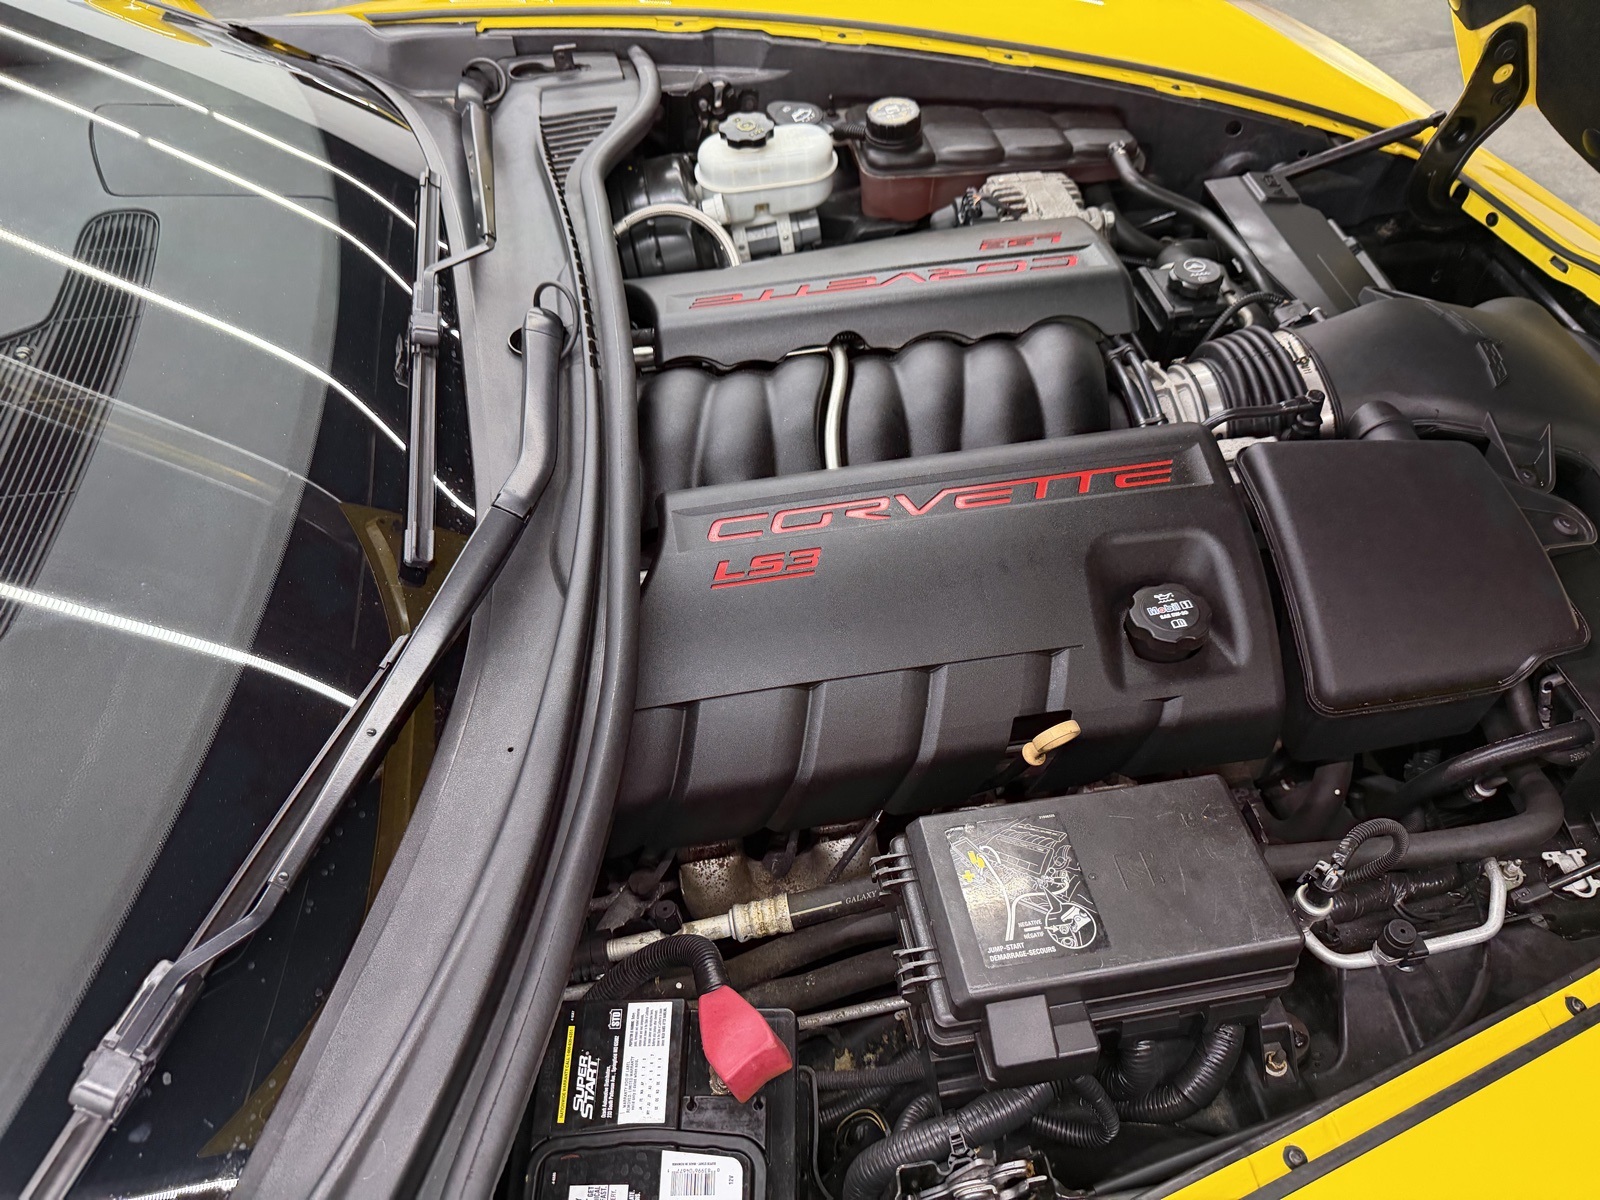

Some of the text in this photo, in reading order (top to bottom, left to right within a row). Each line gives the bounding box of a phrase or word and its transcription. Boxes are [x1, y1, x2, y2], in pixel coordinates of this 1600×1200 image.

[979, 232, 1062, 250] LS3
[689, 255, 1078, 309] CORVETTE
[707, 459, 1173, 542] CORVETTE
[712, 546, 822, 584] LS3
[1146, 600, 1194, 616] Mobil 1
[846, 890, 877, 905] GALAXY
[1018, 919, 1042, 928] NEGATIVE
[988, 942, 1025, 953] JUMP-START
[611, 1012, 621, 1027] STD
[573, 1055, 588, 1111] SUPER
[580, 1055, 598, 1120] START
